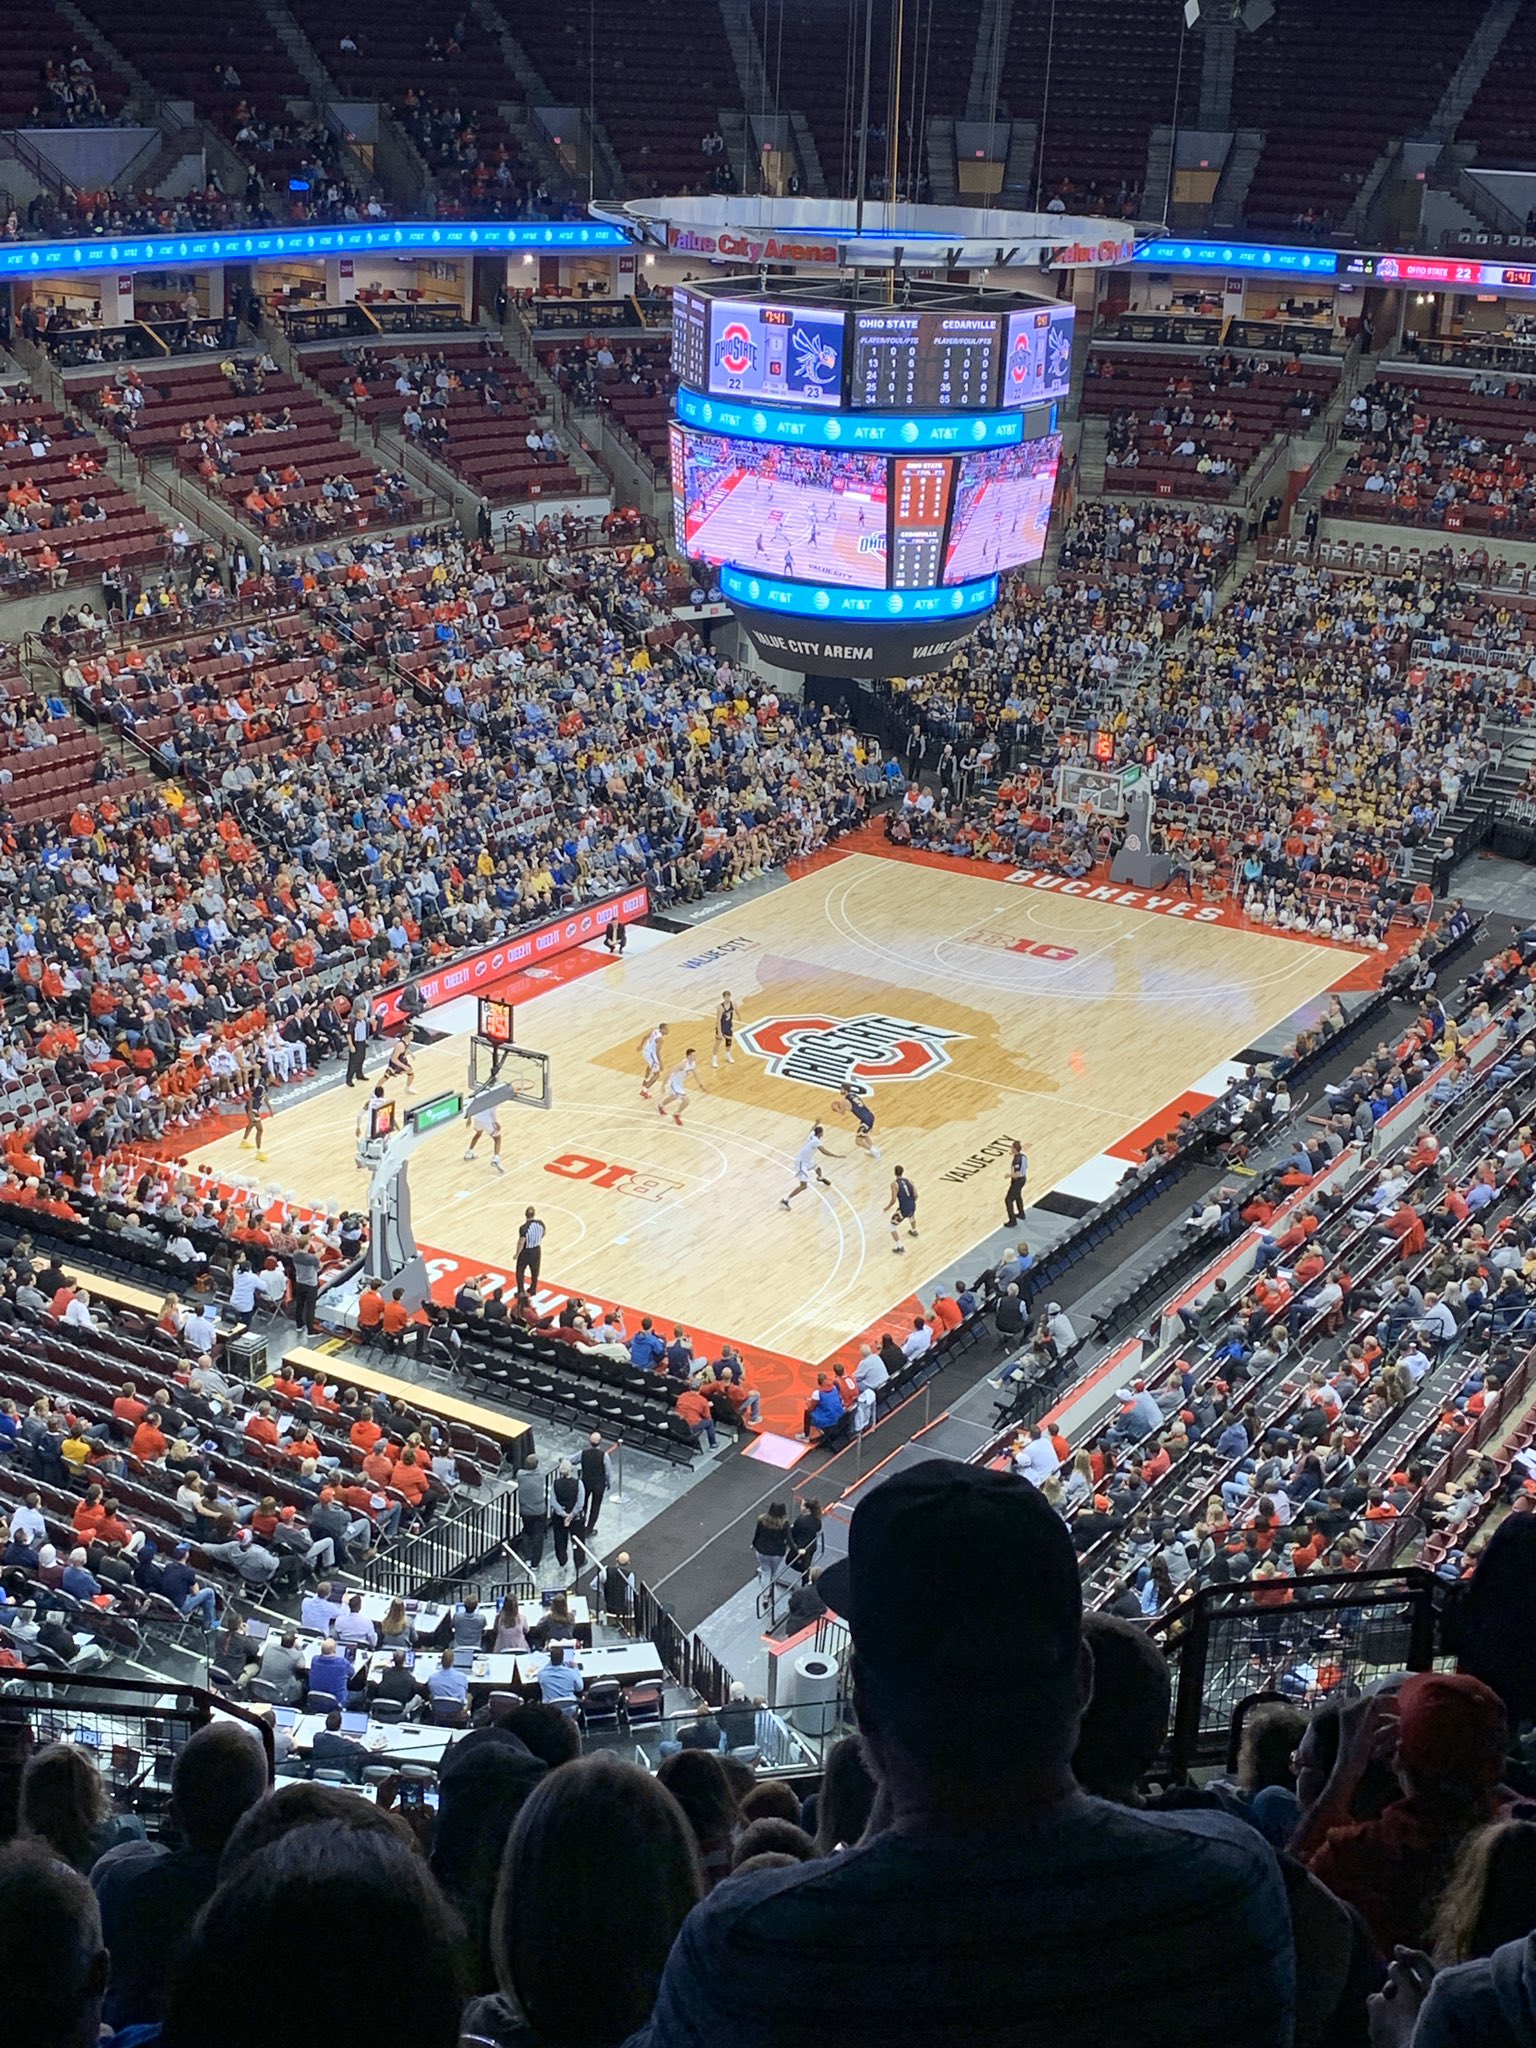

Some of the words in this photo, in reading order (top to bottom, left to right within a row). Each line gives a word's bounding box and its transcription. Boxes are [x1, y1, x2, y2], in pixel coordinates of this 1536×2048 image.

[669, 228, 716, 253] Value
[764, 239, 837, 262] Arena
[1407, 265, 1426, 275] OHIO
[1427, 266, 1449, 277] STATE
[1455, 268, 1472, 279] 22
[859, 320, 885, 329] OHIO
[886, 320, 918, 329] STATE
[942, 320, 996, 330] CEDARVILLE
[866, 371, 877, 380] 24
[890, 371, 896, 380] 1
[908, 371, 914, 380] 3
[943, 371, 950, 380] 5
[962, 371, 969, 380] 0
[981, 371, 988, 380] 6
[728, 379, 741, 390] 22
[865, 383, 877, 392] 25
[888, 383, 895, 392] 0
[907, 383, 913, 392] 3
[940, 383, 951, 392] 35
[964, 383, 969, 392] 1
[980, 383, 987, 392] 0
[806, 388, 820, 398] 23
[865, 395, 876, 404] 34
[889, 395, 894, 404] 1
[940, 395, 950, 404] 55
[961, 395, 968, 404] 0
[719, 413, 741, 427] AT&T
[777, 422, 806, 435] AT&T
[854, 427, 885, 439] AT&T
[930, 427, 959, 440] AT&T
[995, 424, 1018, 436] AT&T
[842, 598, 872, 610] AT&T
[913, 598, 940, 610] AT&T
[752, 630, 784, 651] VALUE
[791, 640, 819, 656] CITY
[824, 646, 873, 660] ARENA
[912, 641, 950, 659] VALUE
[1003, 869, 1225, 922] BUCKEYES
[677, 950, 727, 969] VALUE
[717, 936, 754, 952] CITY
[799, 1017, 965, 1060] STATE
[782, 1046, 867, 1095] OHIO
[939, 1154, 996, 1183] VALUE
[980, 1134, 1016, 1157] CITY
